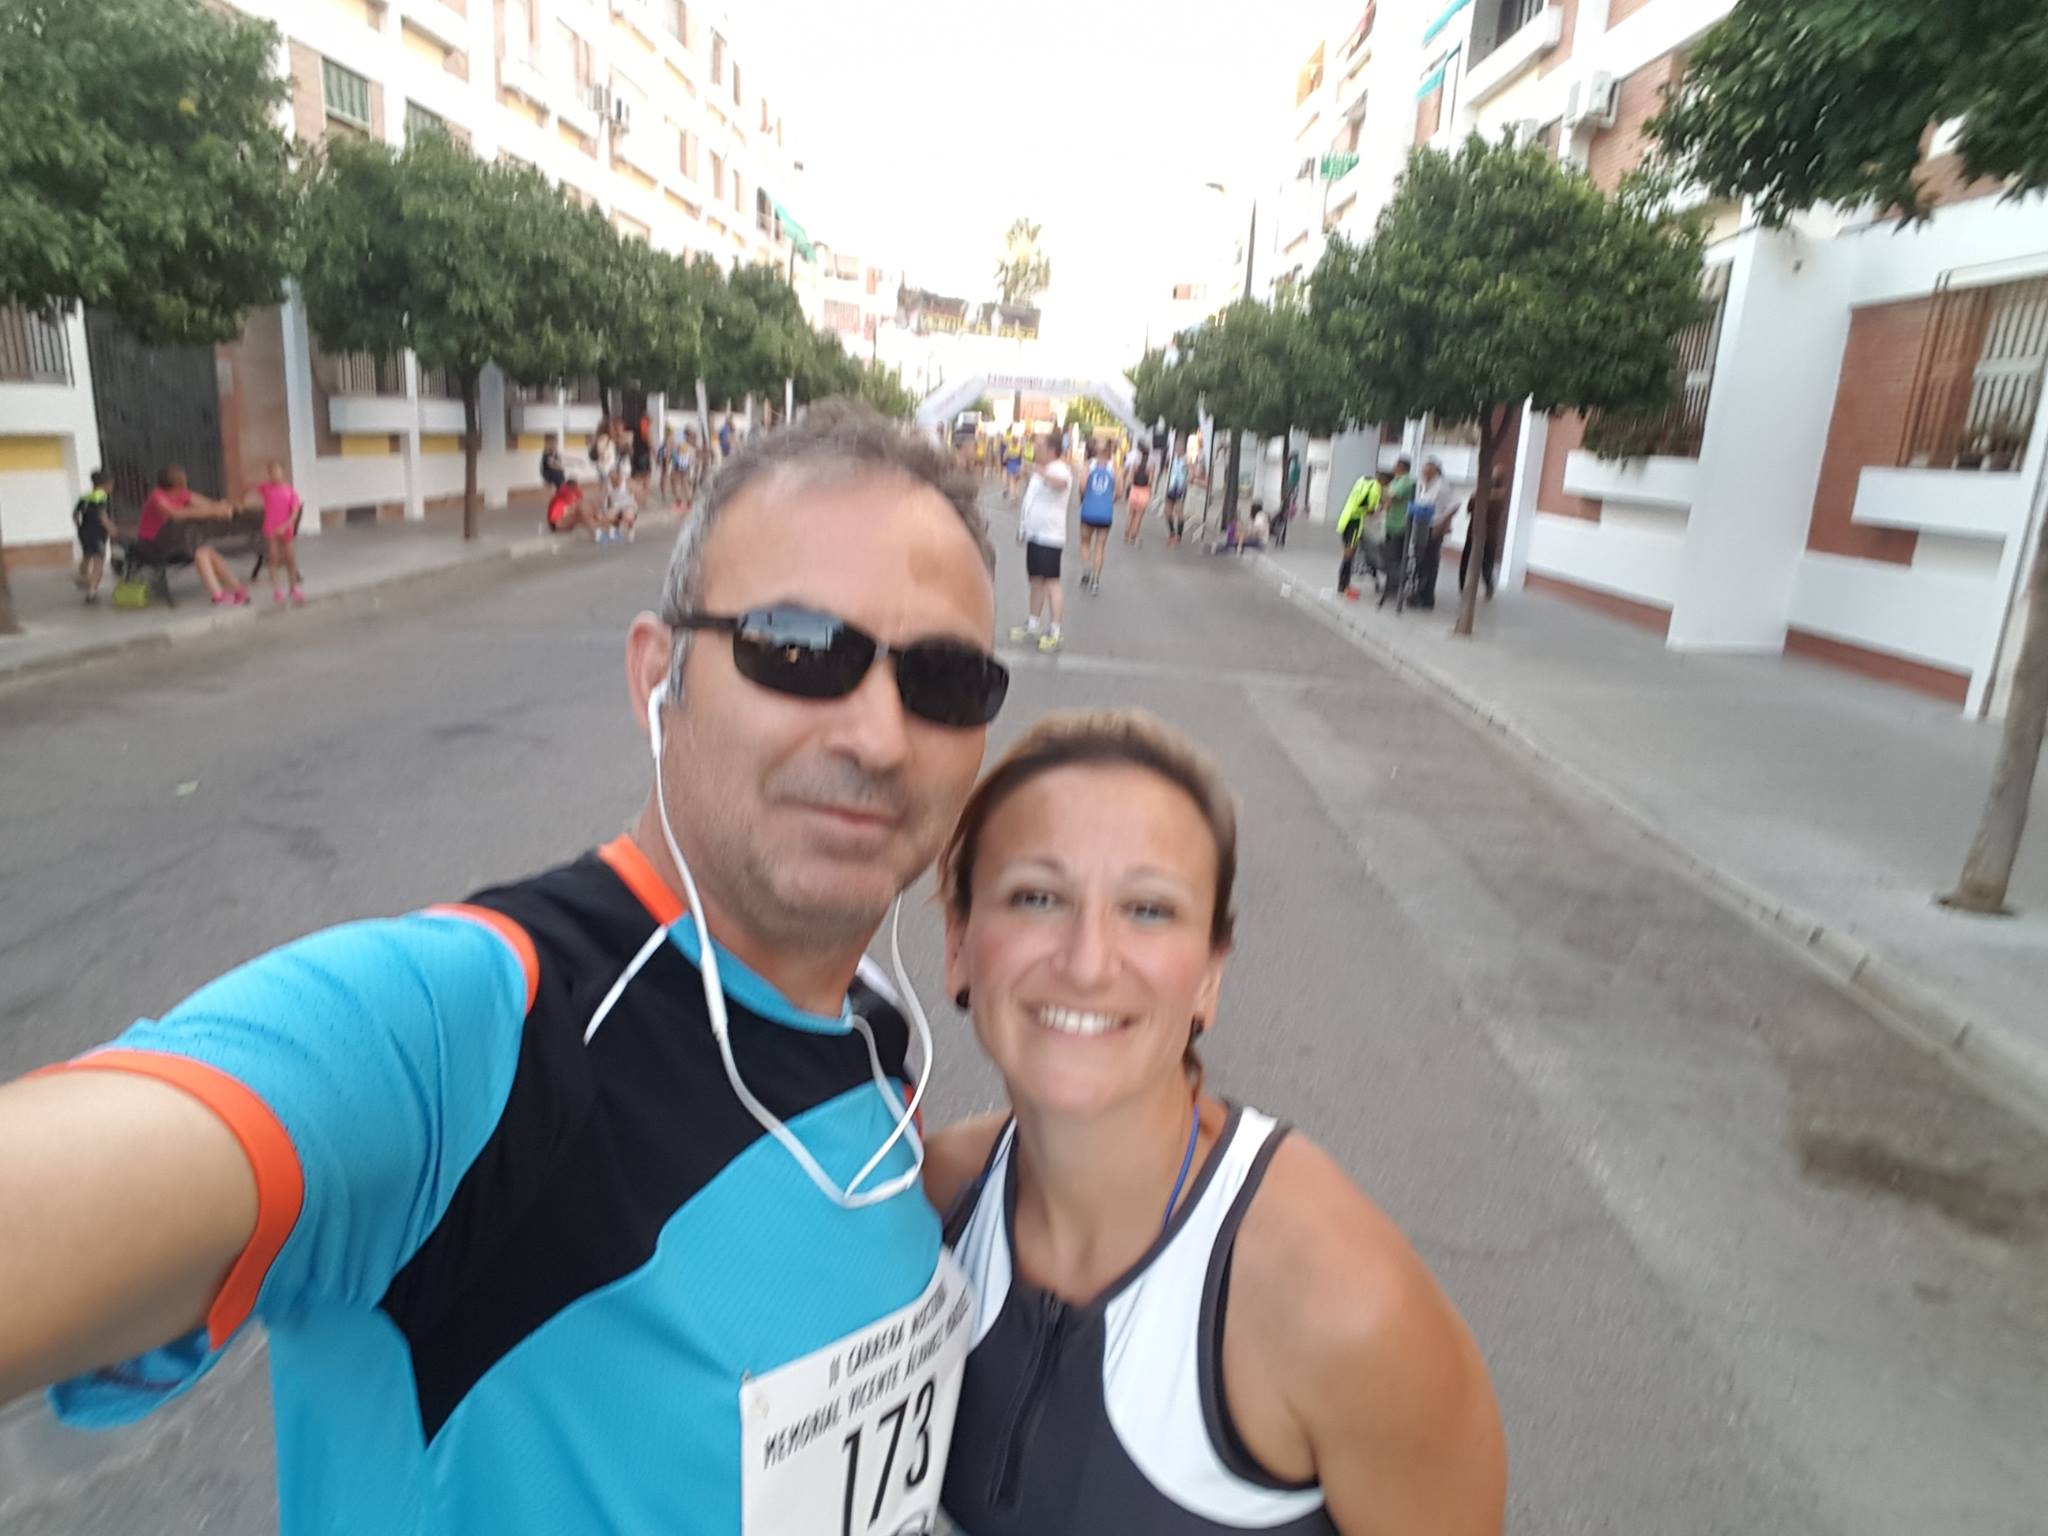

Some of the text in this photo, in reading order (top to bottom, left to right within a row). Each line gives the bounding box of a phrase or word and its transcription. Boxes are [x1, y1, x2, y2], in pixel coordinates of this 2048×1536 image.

[847, 1319, 905, 1377] CARRERA
[764, 1396, 842, 1470] MEMORIAL
[847, 1359, 901, 1417] VICENTE
[841, 1375, 936, 1536] 173
